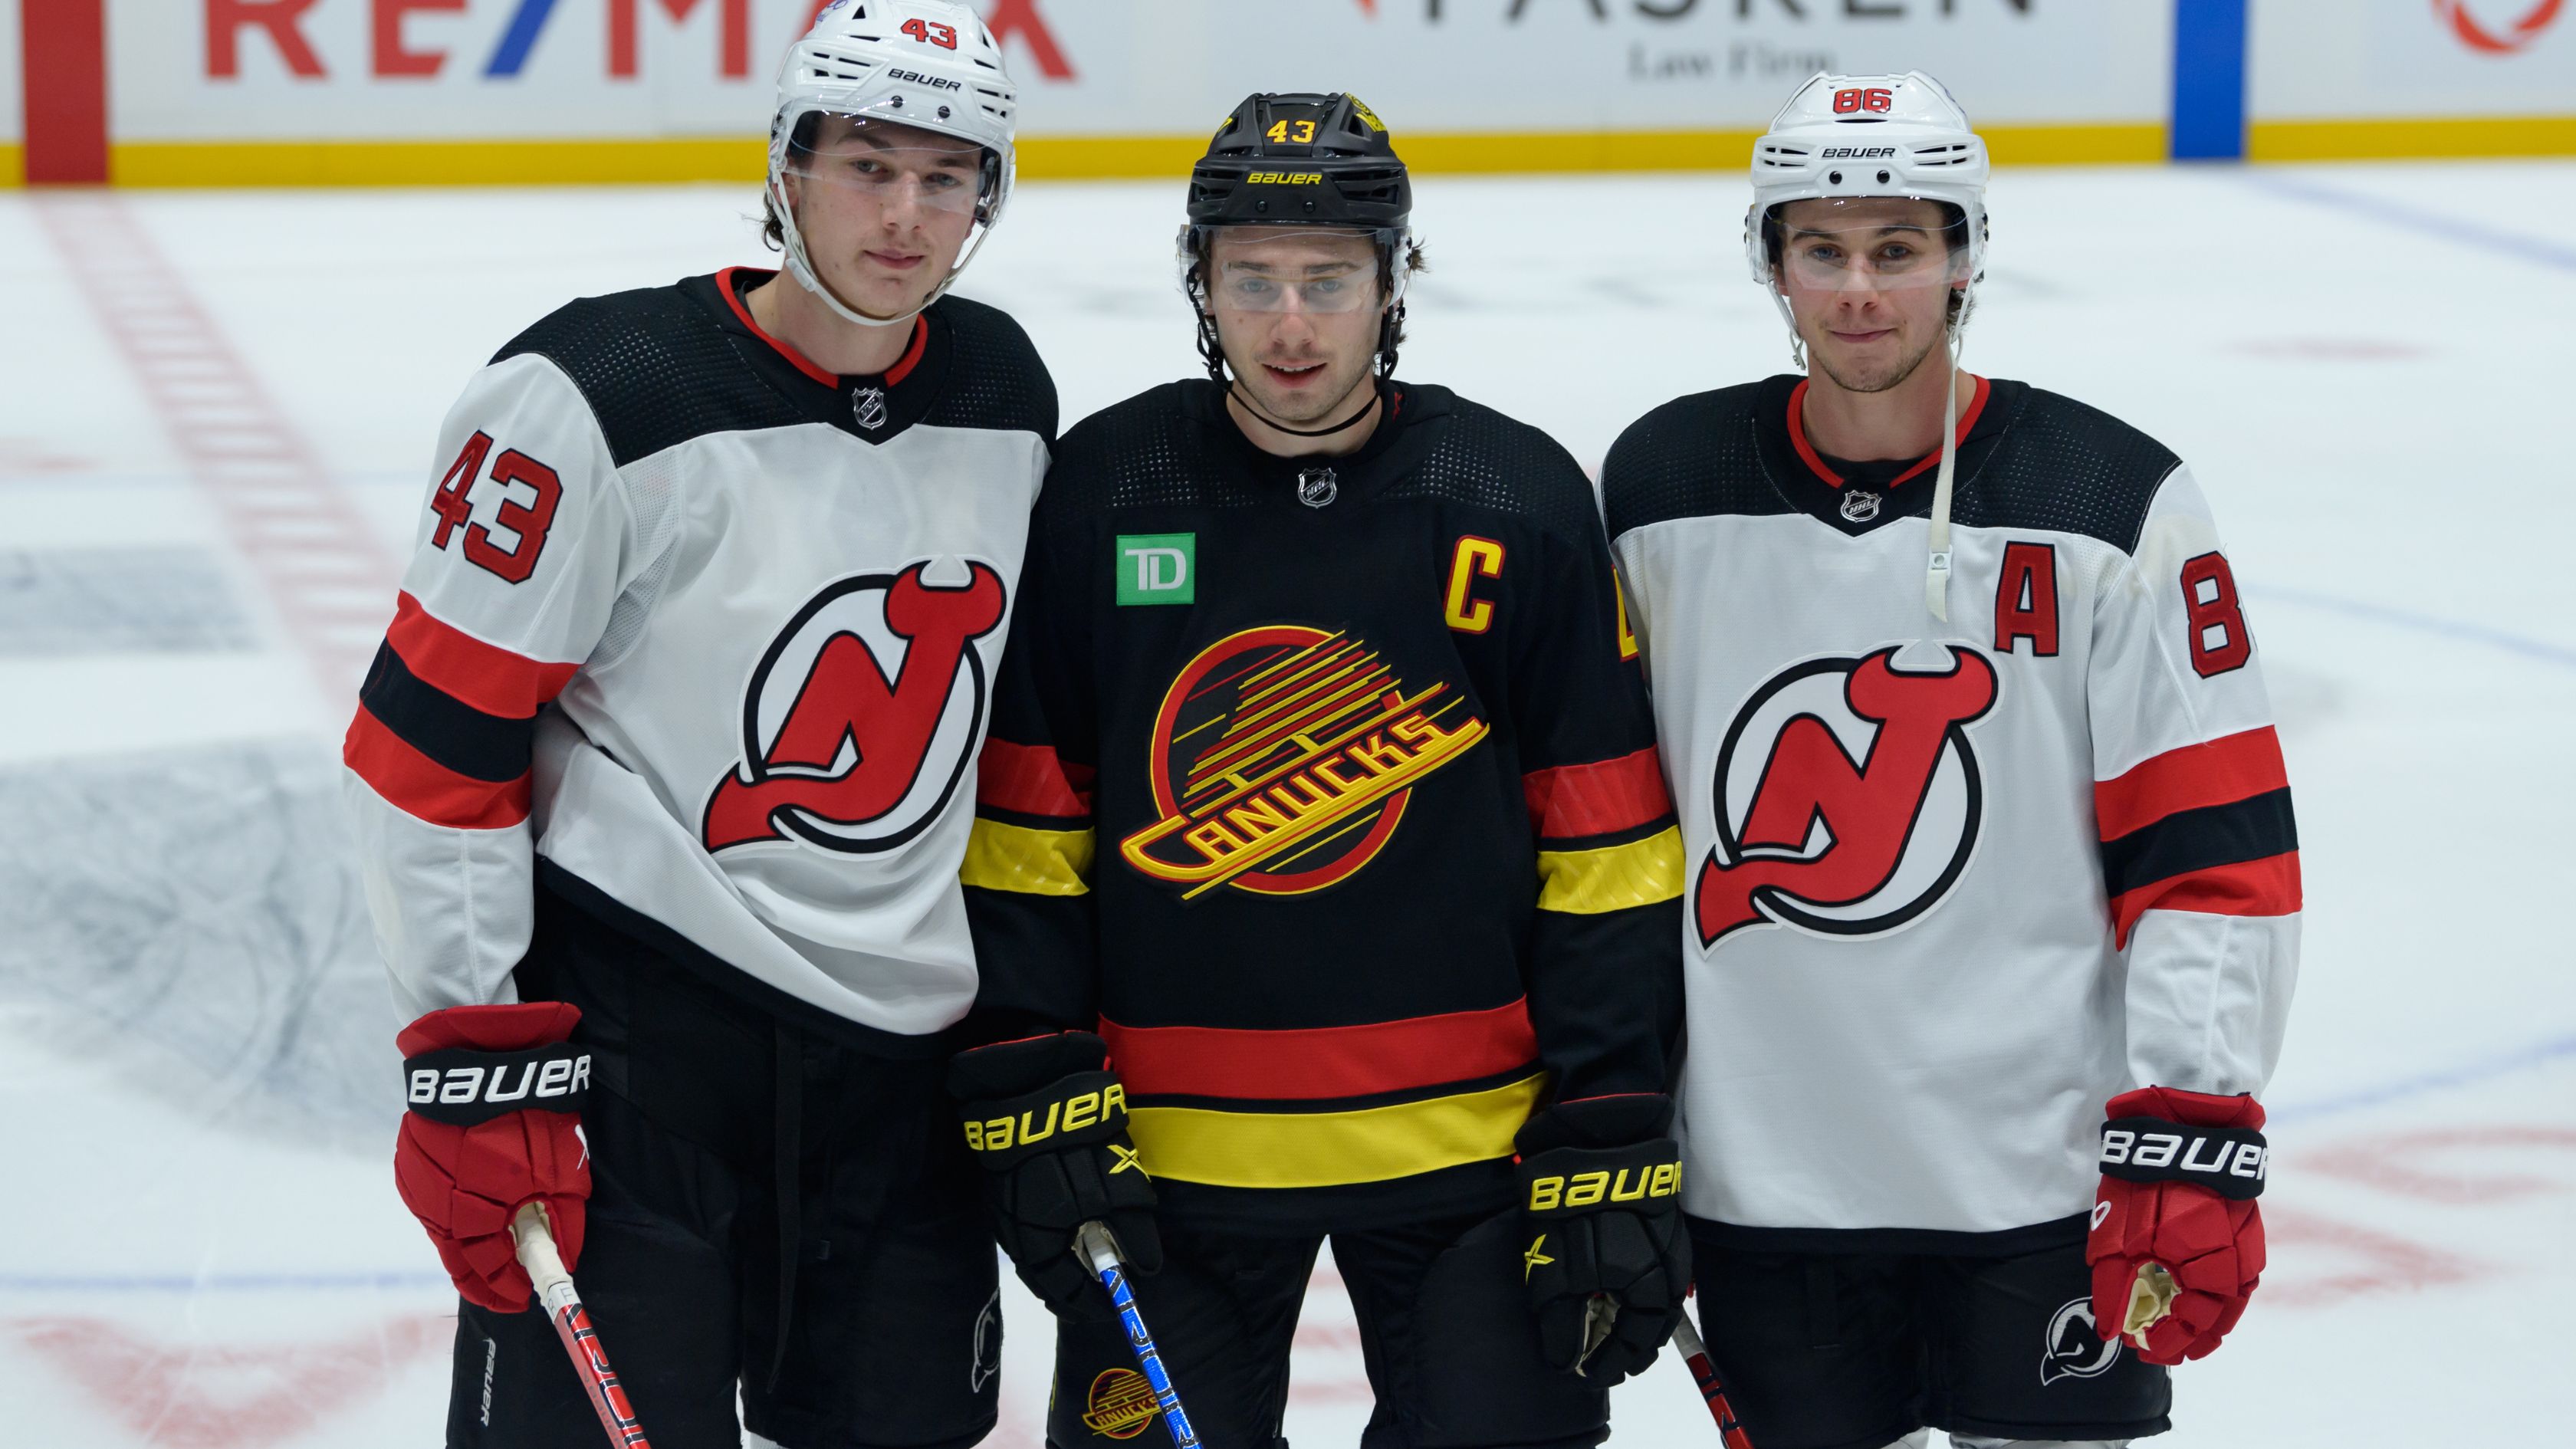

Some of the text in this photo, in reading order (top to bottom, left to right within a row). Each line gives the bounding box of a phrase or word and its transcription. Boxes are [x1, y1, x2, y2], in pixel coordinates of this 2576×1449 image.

[901, 18, 957, 51] 43
[1833, 88, 1892, 114] 86
[1267, 120, 1316, 144] 43
[430, 429, 564, 585] 43
[1848, 500, 1875, 515] NHL
[1125, 547, 1187, 591] TD
[1444, 534, 1506, 635] C
[1994, 541, 2060, 657] A
